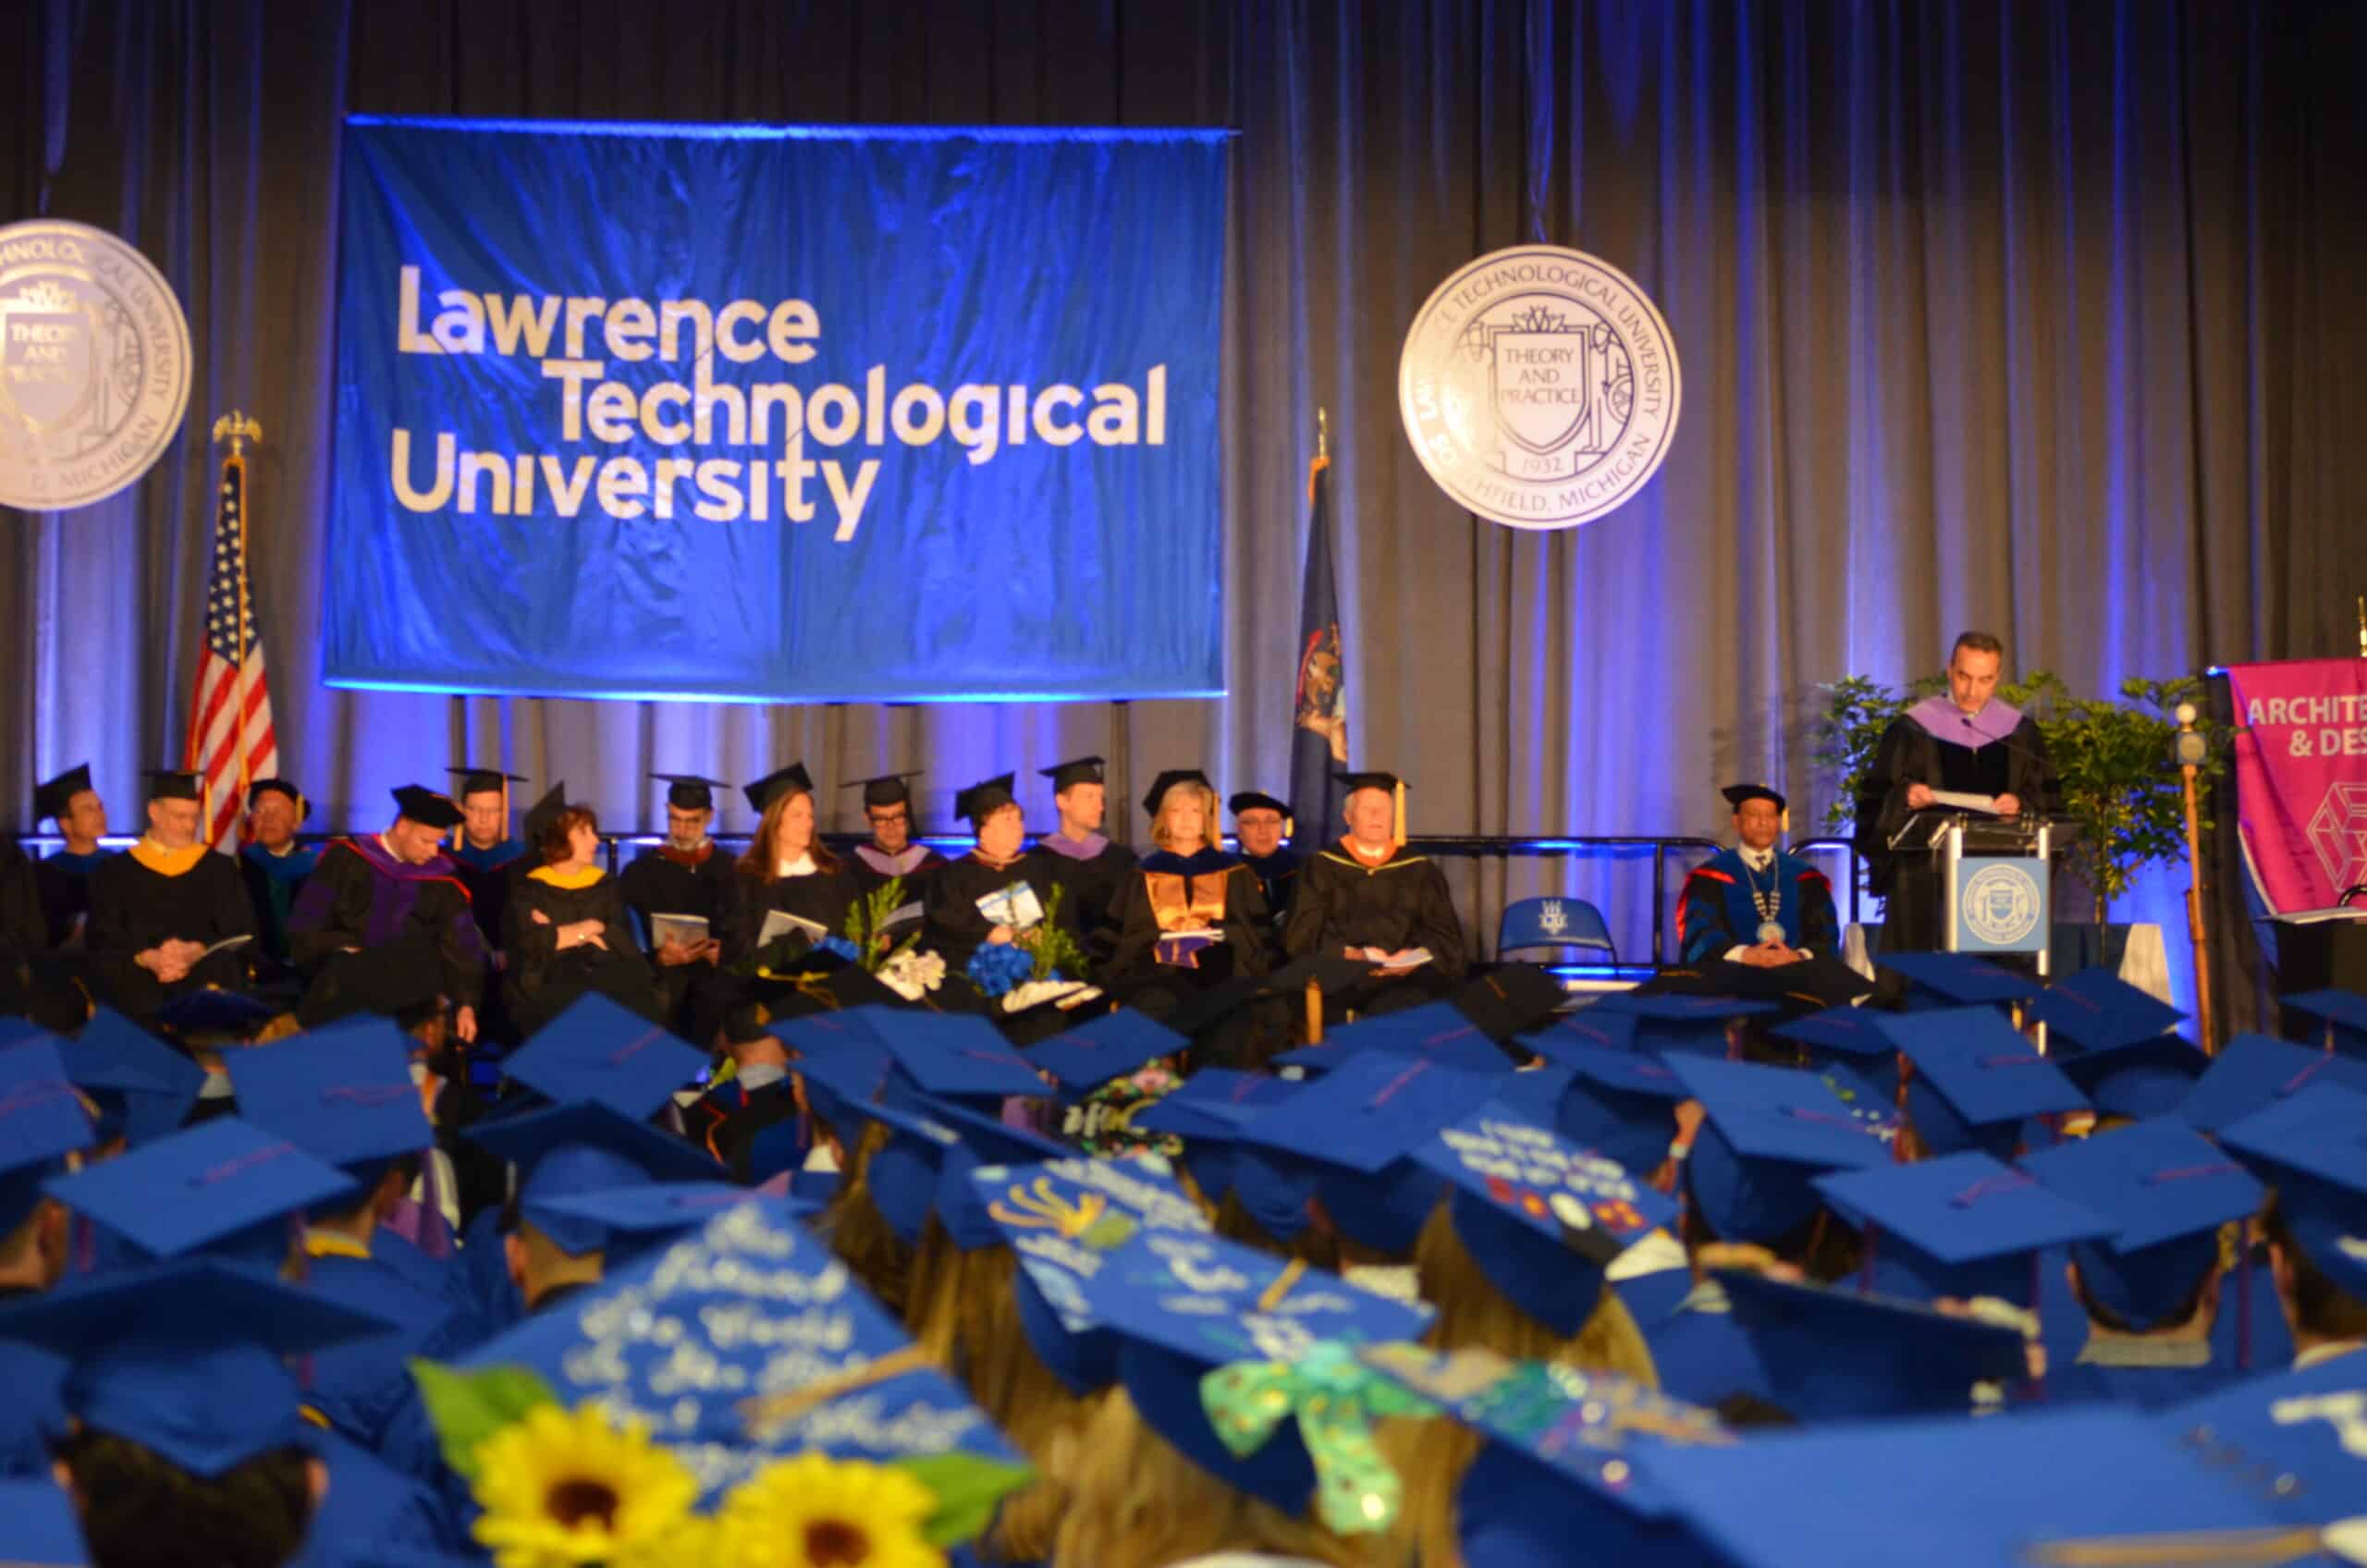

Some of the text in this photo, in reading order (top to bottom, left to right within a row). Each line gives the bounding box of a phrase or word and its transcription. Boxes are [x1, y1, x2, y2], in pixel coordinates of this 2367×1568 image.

[399, 266, 821, 364] Lawrence
[1453, 264, 1663, 422] TECHNOLOGICAL UNIVERSITY
[1504, 348, 1575, 365] THEORY
[1501, 386, 1581, 405] PRACTICE
[1517, 370, 1561, 386] AND
[541, 359, 1168, 466] Technological
[391, 428, 881, 542] University
[1522, 456, 1563, 474] 1932
[1558, 434, 1651, 508] MICHIGAN
[2289, 729, 2313, 757] &
